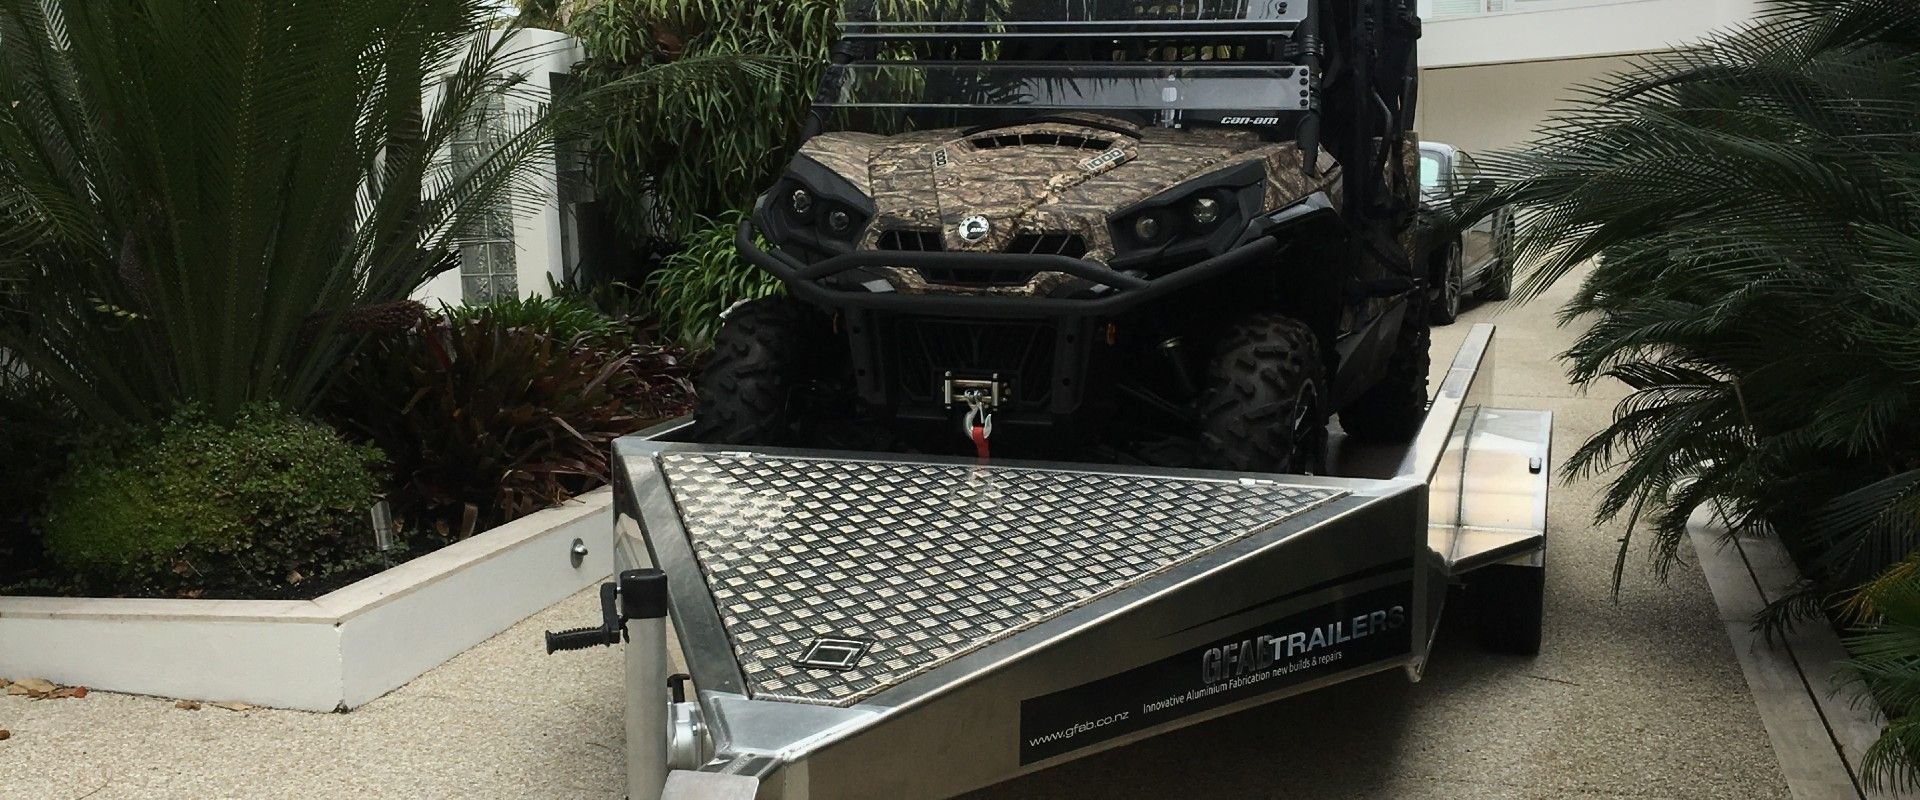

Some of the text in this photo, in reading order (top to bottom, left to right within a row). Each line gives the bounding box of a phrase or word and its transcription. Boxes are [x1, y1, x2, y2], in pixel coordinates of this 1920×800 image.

[1143, 650, 1343, 714] Innovative Aluminium Fabrication new builds & repairs
[1029, 711, 1130, 747] www.gfab.co.nz
